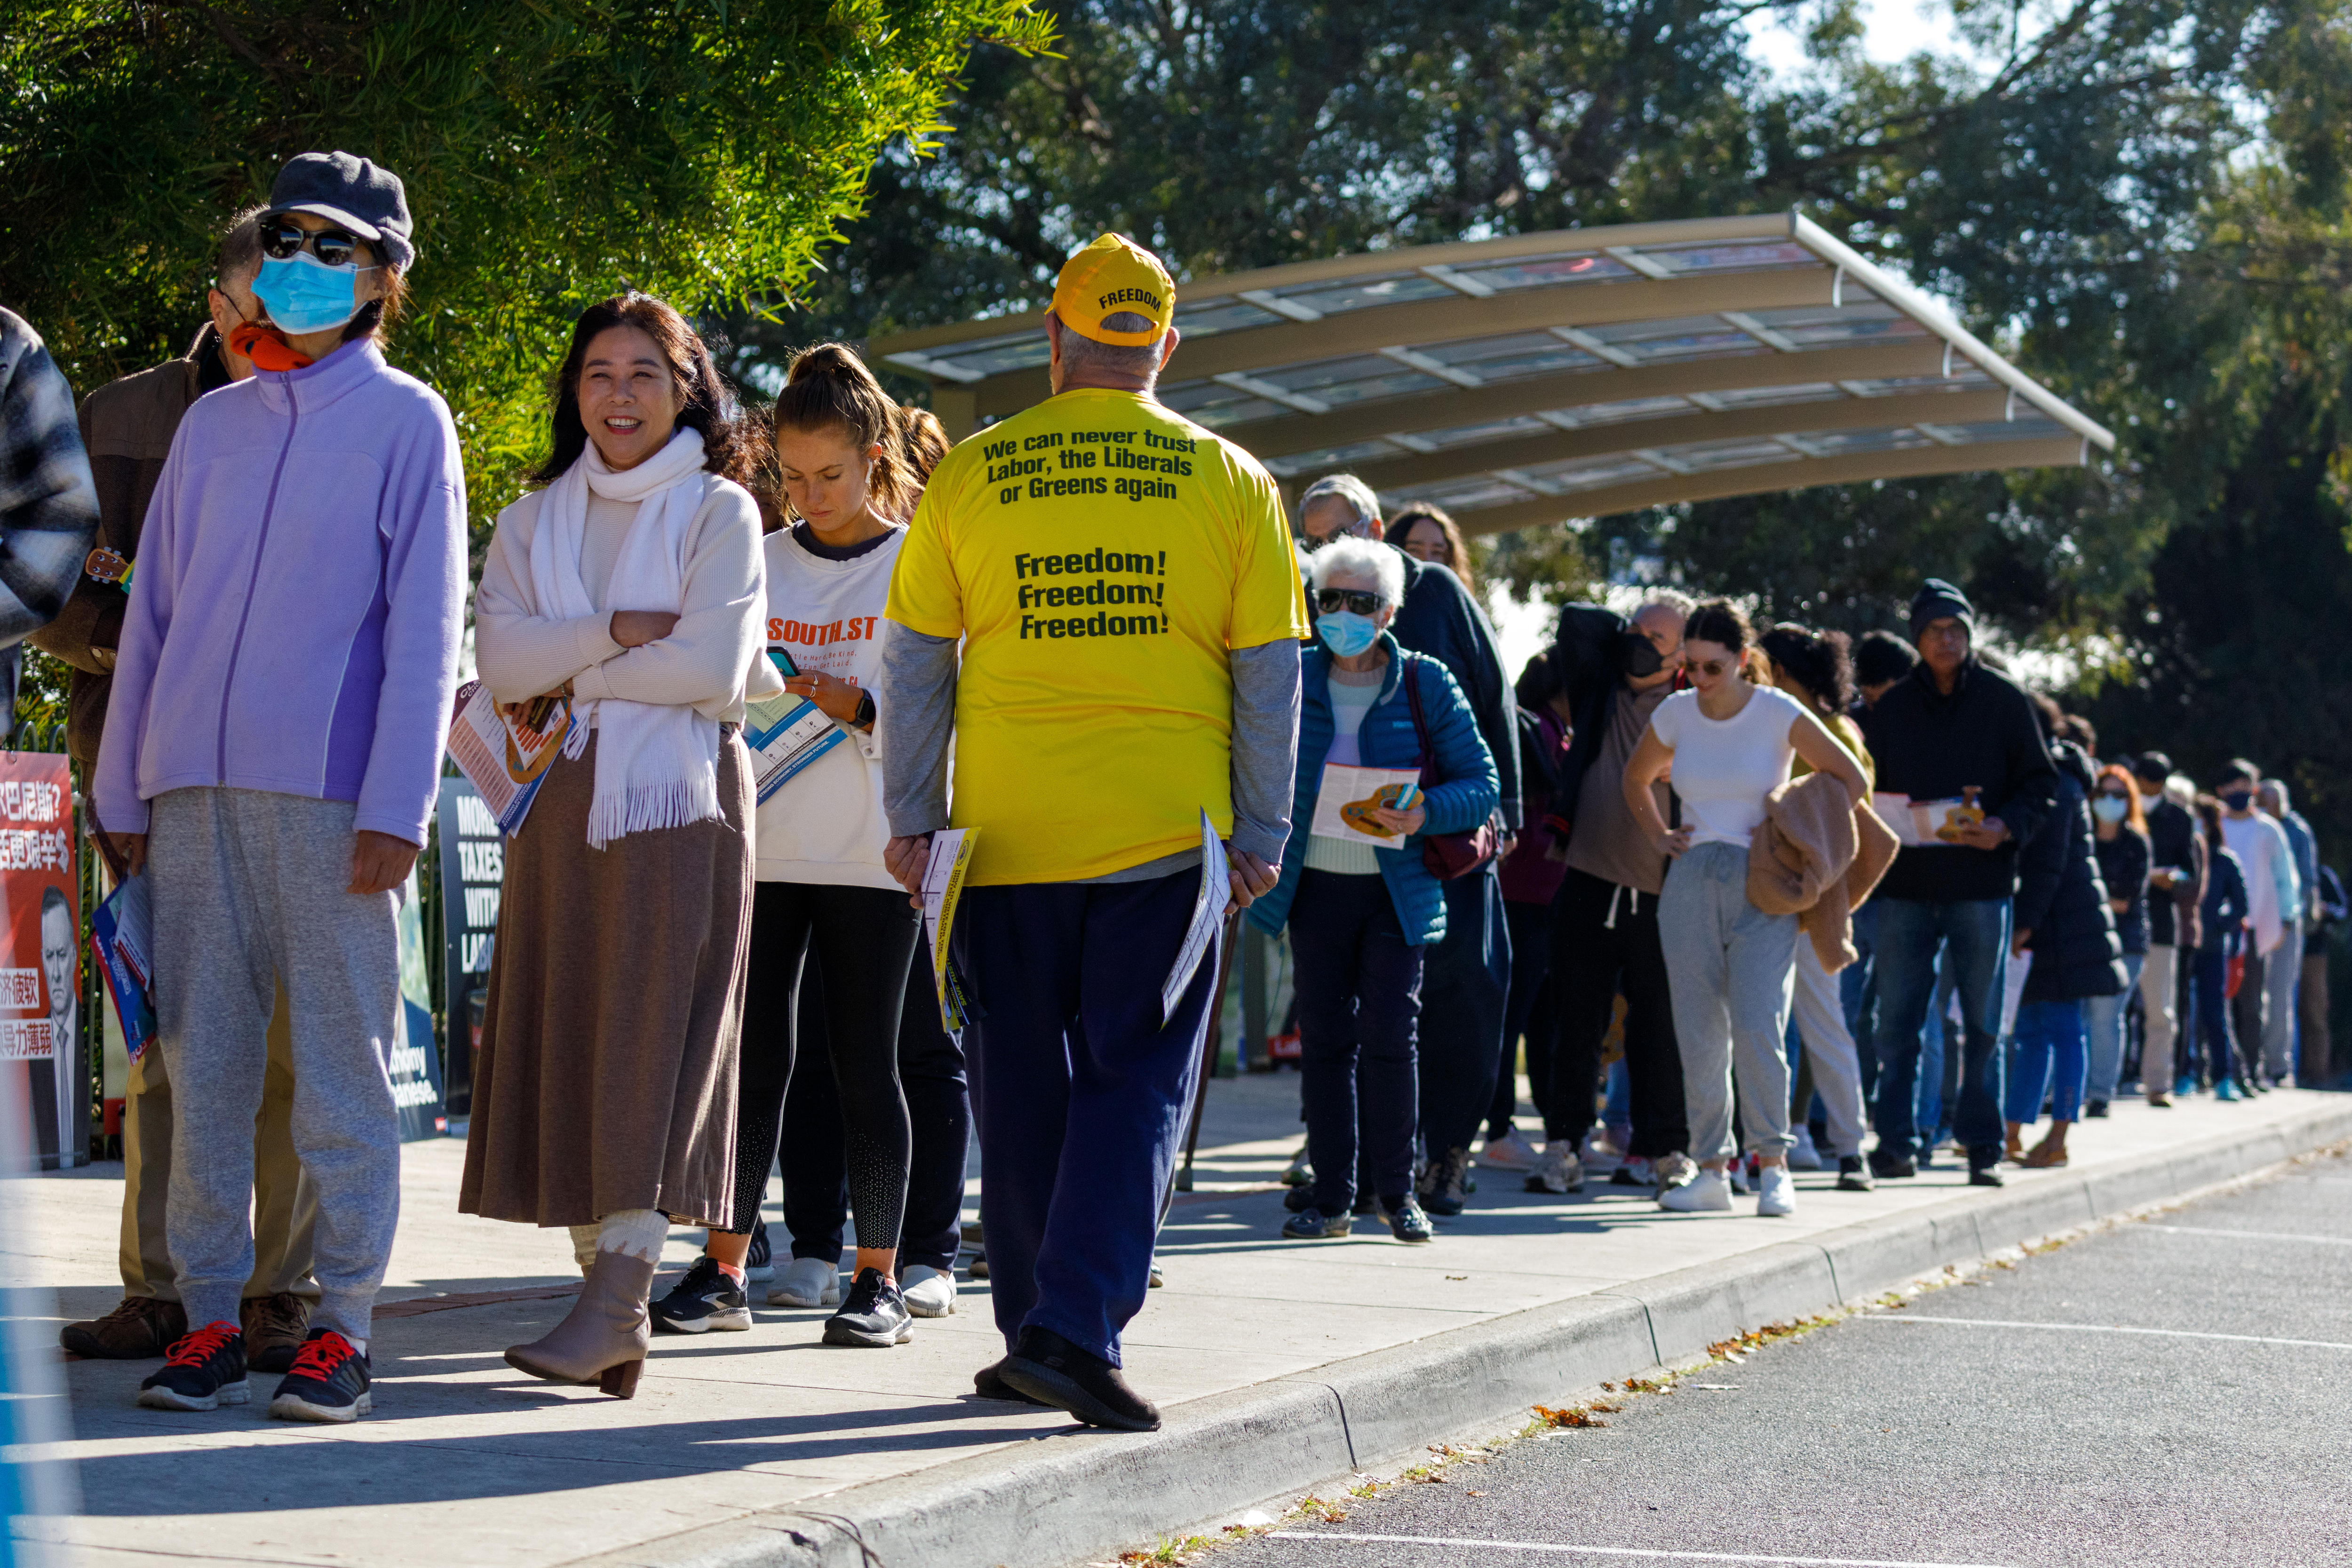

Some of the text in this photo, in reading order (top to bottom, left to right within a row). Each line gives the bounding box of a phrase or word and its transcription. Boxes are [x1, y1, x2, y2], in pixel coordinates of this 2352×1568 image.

[1099, 288, 1161, 312] FREEDOM
[984, 430, 1196, 462] We can never trust
[987, 446, 1192, 484] Labor, the Liberals
[1000, 477, 1176, 504] or Greens again
[1015, 547, 1166, 579] Freedom!
[1018, 580, 1164, 609] Freedom!
[767, 617, 878, 646] SOUTH.ST
[1020, 612, 1168, 639] Freedom!
[758, 740, 829, 798] STRONG ECONOMY. STRONGER FUTURE.
[501, 782, 528, 824] STRONG ECONOM
[503, 801, 520, 827] STRONGER
[458, 841, 504, 882] TAXES
[464, 887, 501, 927] WITH
[461, 933, 495, 973] LABO
[0, 1022, 52, 1056] 导力薄弱
[389, 1045, 427, 1078] thony
[391, 1079, 438, 1108] anese.
